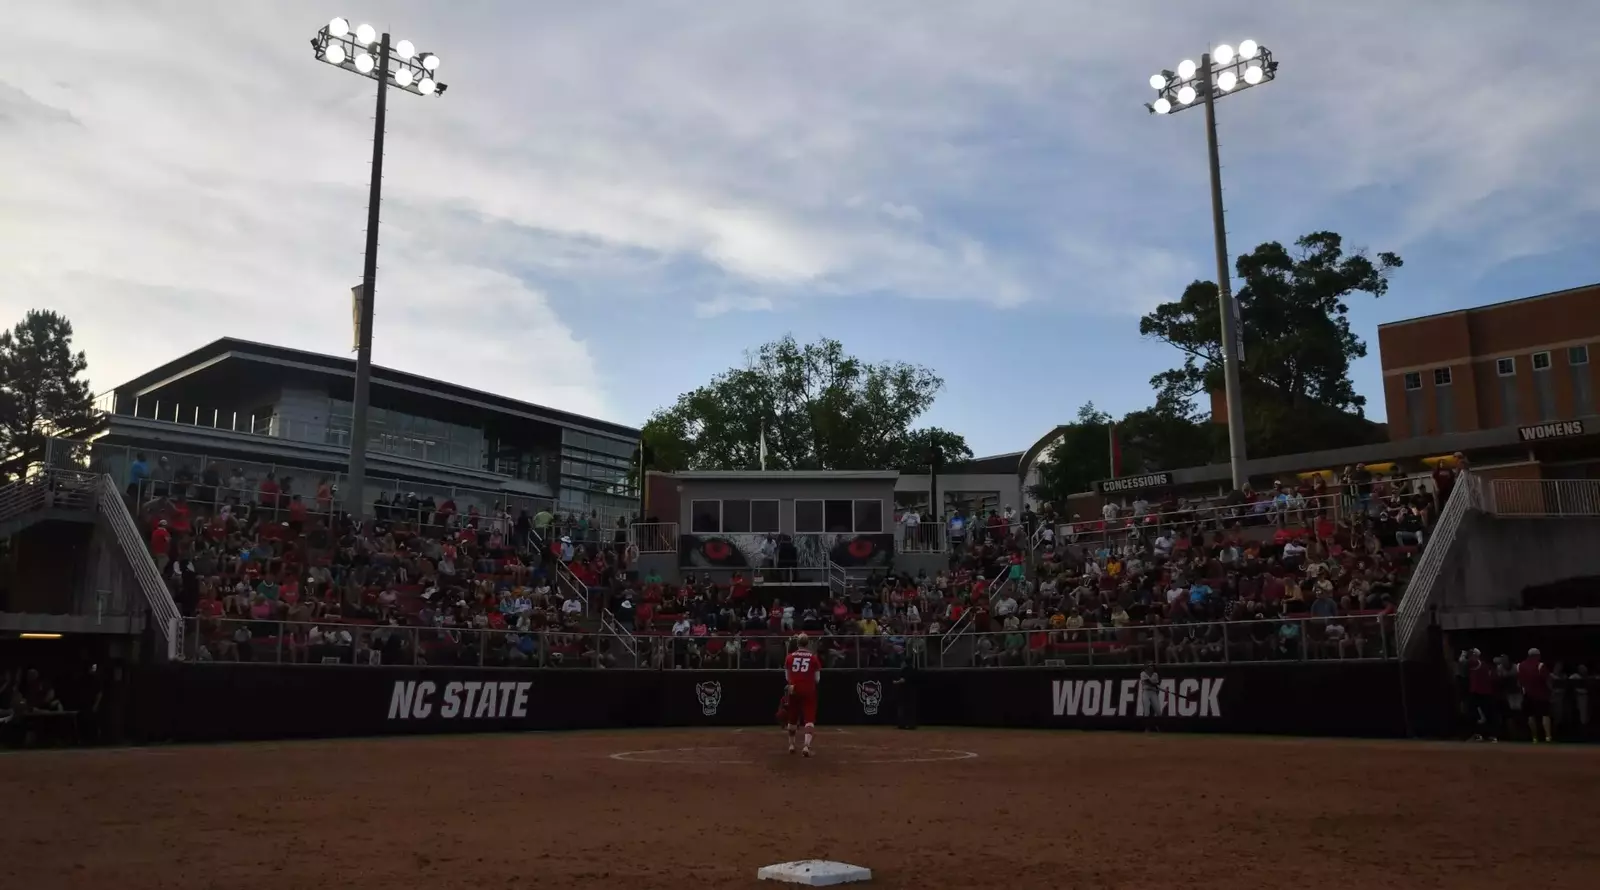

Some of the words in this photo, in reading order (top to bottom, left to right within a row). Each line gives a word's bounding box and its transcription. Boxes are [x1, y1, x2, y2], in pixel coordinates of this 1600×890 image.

[1520, 421, 1582, 441] WOMENS
[1102, 473, 1168, 492] CONCESSIONS
[791, 657, 811, 673] 55
[387, 680, 437, 719] NC
[440, 681, 533, 719] STATE
[1051, 677, 1225, 717] WOLFACK
